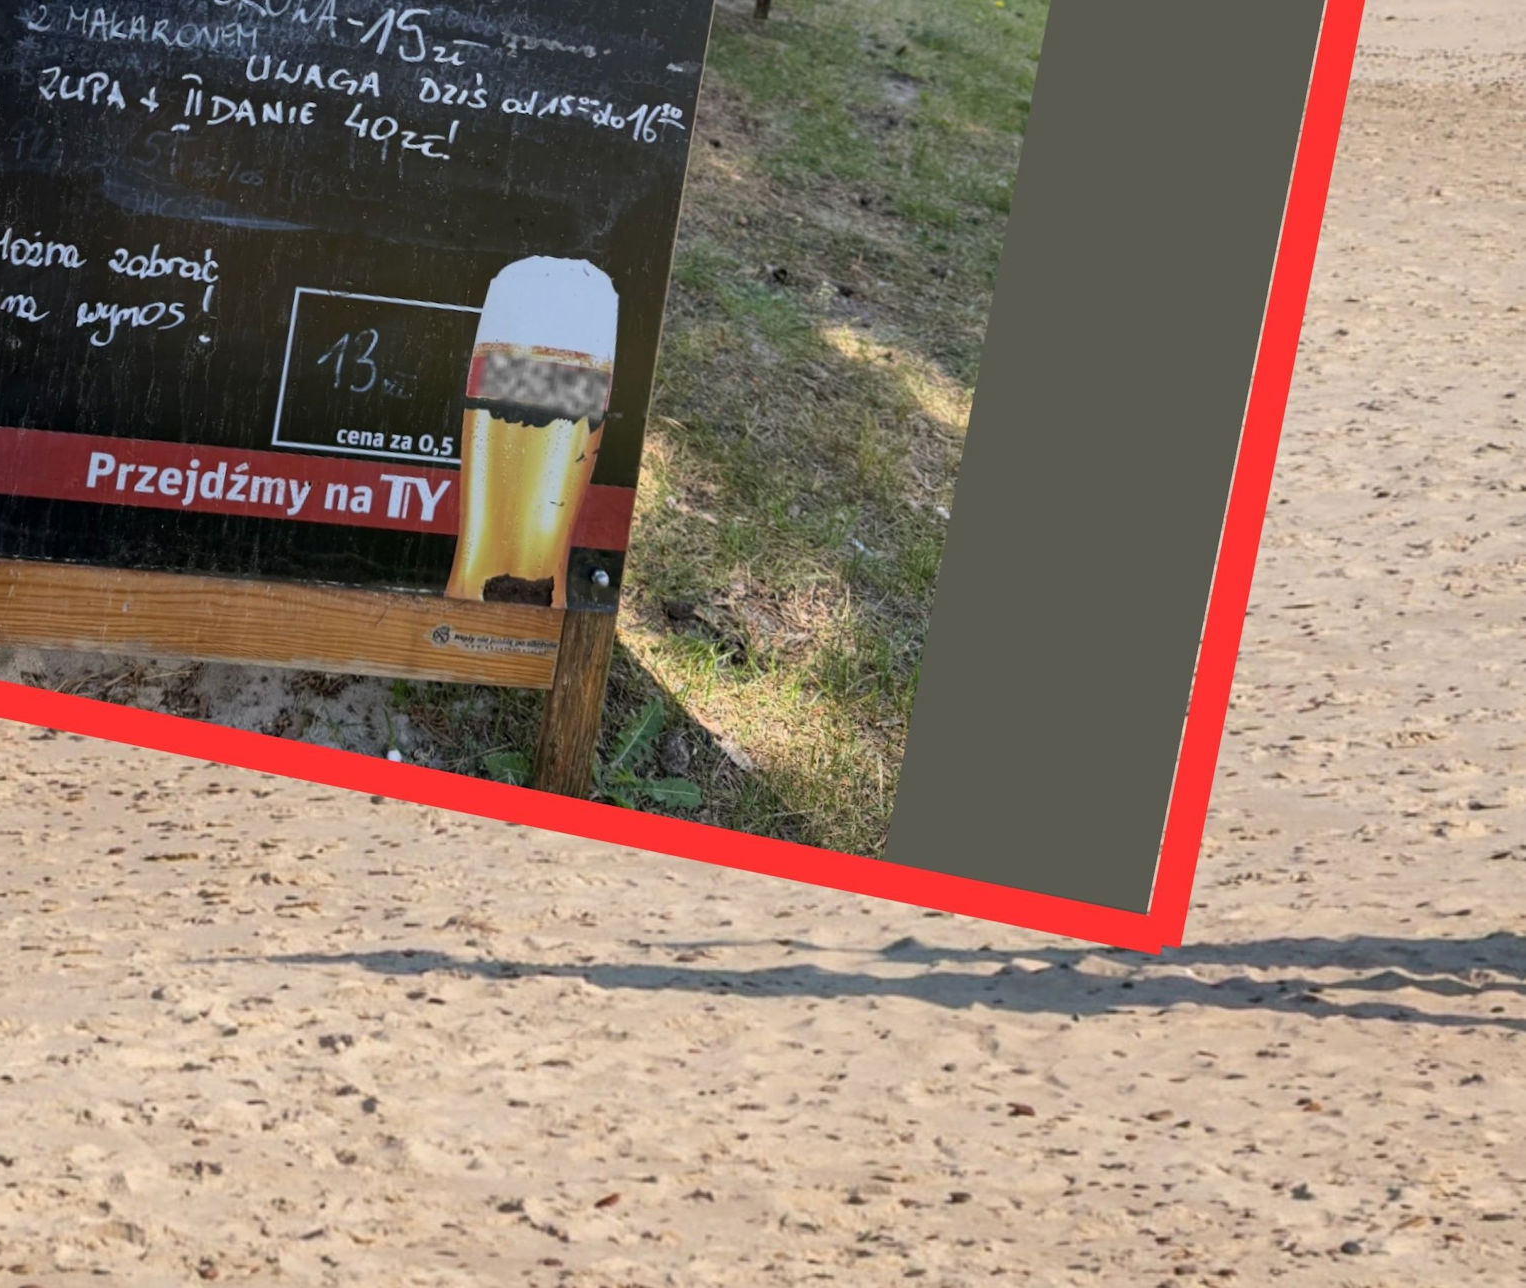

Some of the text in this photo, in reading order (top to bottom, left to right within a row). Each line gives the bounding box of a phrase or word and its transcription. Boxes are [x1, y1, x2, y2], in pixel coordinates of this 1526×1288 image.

[65, 4, 259, 49] MAKARONEM
[38, 65, 127, 110] ZUPA
[139, 85, 160, 113] +
[206, 95, 318, 128] DANIE
[246, 54, 381, 98] UWAGA
[419, 72, 488, 109] DZIŚ
[501, 91, 539, 116] od
[592, 102, 626, 130] do
[108, 242, 220, 284] zabrać
[0, 293, 51, 323] na
[336, 427, 455, 457] cena za 0,5
[85, 450, 312, 517] Przejdźmy
[323, 479, 373, 515] na
